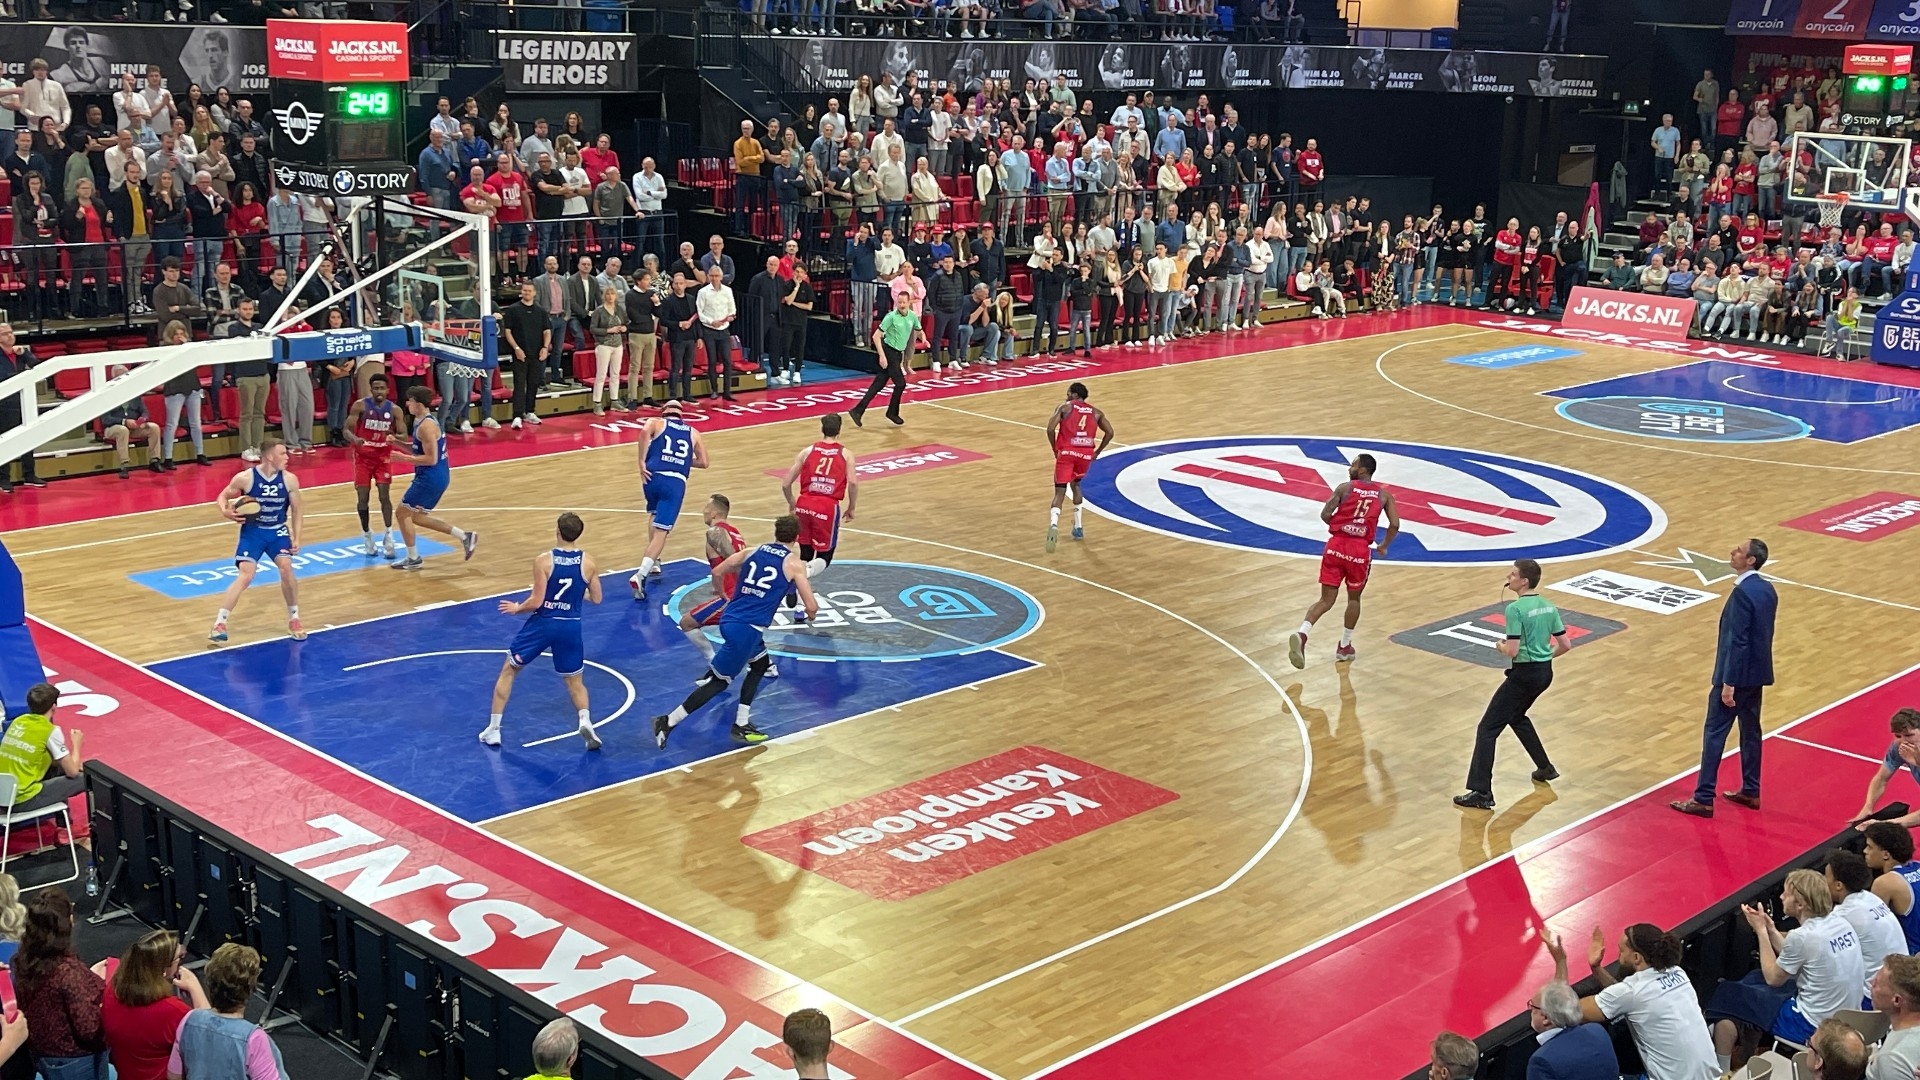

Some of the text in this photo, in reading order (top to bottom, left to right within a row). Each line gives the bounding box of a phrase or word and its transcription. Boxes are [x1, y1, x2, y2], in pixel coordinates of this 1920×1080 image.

[1737, 18, 1784, 31] anycoin
[1805, 21, 1855, 34] anycoin
[1879, 23, 1920, 36] anyco
[275, 38, 317, 54] JACKS.NL
[328, 41, 403, 55] JACKS.NL
[499, 39, 631, 61] LEGENDARY
[1850, 54, 1888, 63] JACKS.NL
[2, 63, 25, 74] ICE
[110, 64, 148, 75] HENK
[241, 65, 266, 76] JOS
[523, 64, 608, 84] HEROES
[827, 69, 849, 77] PAUL
[1329, 70, 1340, 78] JO
[1388, 72, 1424, 81] MARCEL
[1473, 75, 1497, 83] LEON
[1386, 81, 1415, 89] AARTS
[1472, 84, 1514, 93] RODGERS
[1561, 79, 1594, 88] STEFAN
[1559, 88, 1597, 97] WESSELS
[289, 117, 307, 130] MINI
[1853, 116, 1881, 125] STORY
[299, 170, 329, 189] STORY
[357, 173, 410, 189] STORY
[1572, 297, 1684, 328] JACKS.NL
[326, 334, 372, 346] Schelde
[1479, 319, 1782, 365] JACKS.NL
[326, 342, 373, 355] Sports
[1078, 414, 1088, 431] 4
[661, 434, 690, 458] 13
[815, 457, 834, 476] 21
[262, 484, 279, 497] 32
[1352, 499, 1373, 518] 15
[743, 561, 778, 590] 12
[553, 577, 573, 601] 7
[802, 763, 1082, 857] Kampioen
[887, 790, 1103, 864] Keuken
[1829, 931, 1856, 954] MAST
